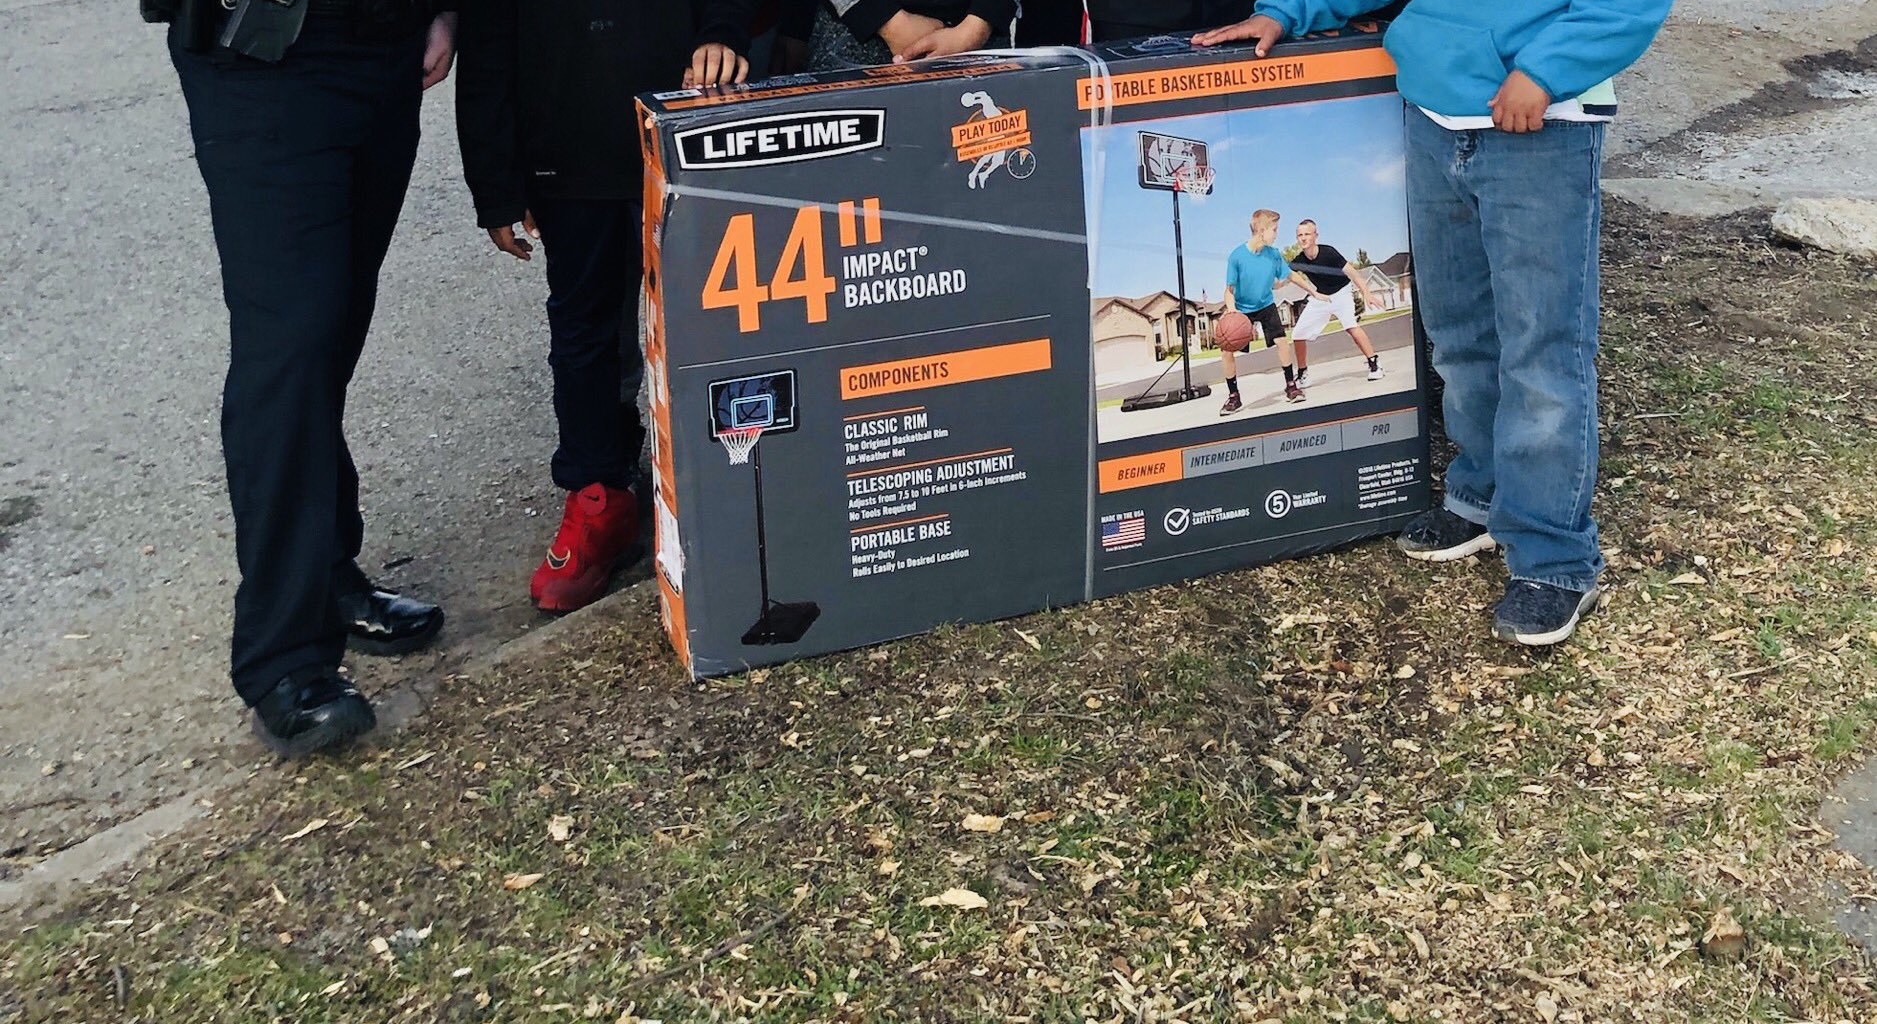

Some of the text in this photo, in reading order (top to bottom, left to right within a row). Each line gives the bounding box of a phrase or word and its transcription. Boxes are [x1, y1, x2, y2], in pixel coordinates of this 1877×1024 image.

[1085, 63, 1305, 101] POTABLE BASKETBALL SYSTEM
[703, 118, 861, 160] LIFETIME
[959, 115, 1021, 142] PLAY TODAY
[844, 269, 968, 308] BACKBOARD
[849, 361, 949, 391] COMPONENTS
[844, 413, 928, 440] CLASSIC RIM
[845, 428, 949, 453] The Original Basketball Rim
[845, 447, 906, 466] All-Weather Net
[1117, 423, 1390, 481] BEGINNER INTERMEDIATE ADVANCED PRO
[847, 455, 1015, 496] TELESCOPING ADJUSTMENT
[848, 497, 877, 509] Adjusts
[878, 493, 896, 504] from
[898, 489, 910, 500] 7.5
[911, 488, 919, 499] to
[921, 486, 930, 497] 10
[931, 484, 949, 495] Feet
[950, 481, 958, 492] in
[985, 471, 1027, 486] Increments
[849, 501, 916, 522] No Tools Required
[1101, 509, 1145, 523] MADE IN THE USA
[1192, 508, 1251, 526] SAFETY STANDARDS
[1272, 495, 1327, 514] 5 WARRANTY
[851, 521, 951, 552] PORTABLE BASE
[852, 549, 896, 565] Heavy-Duty
[852, 548, 970, 578] Rolls Easily to Desired Location
